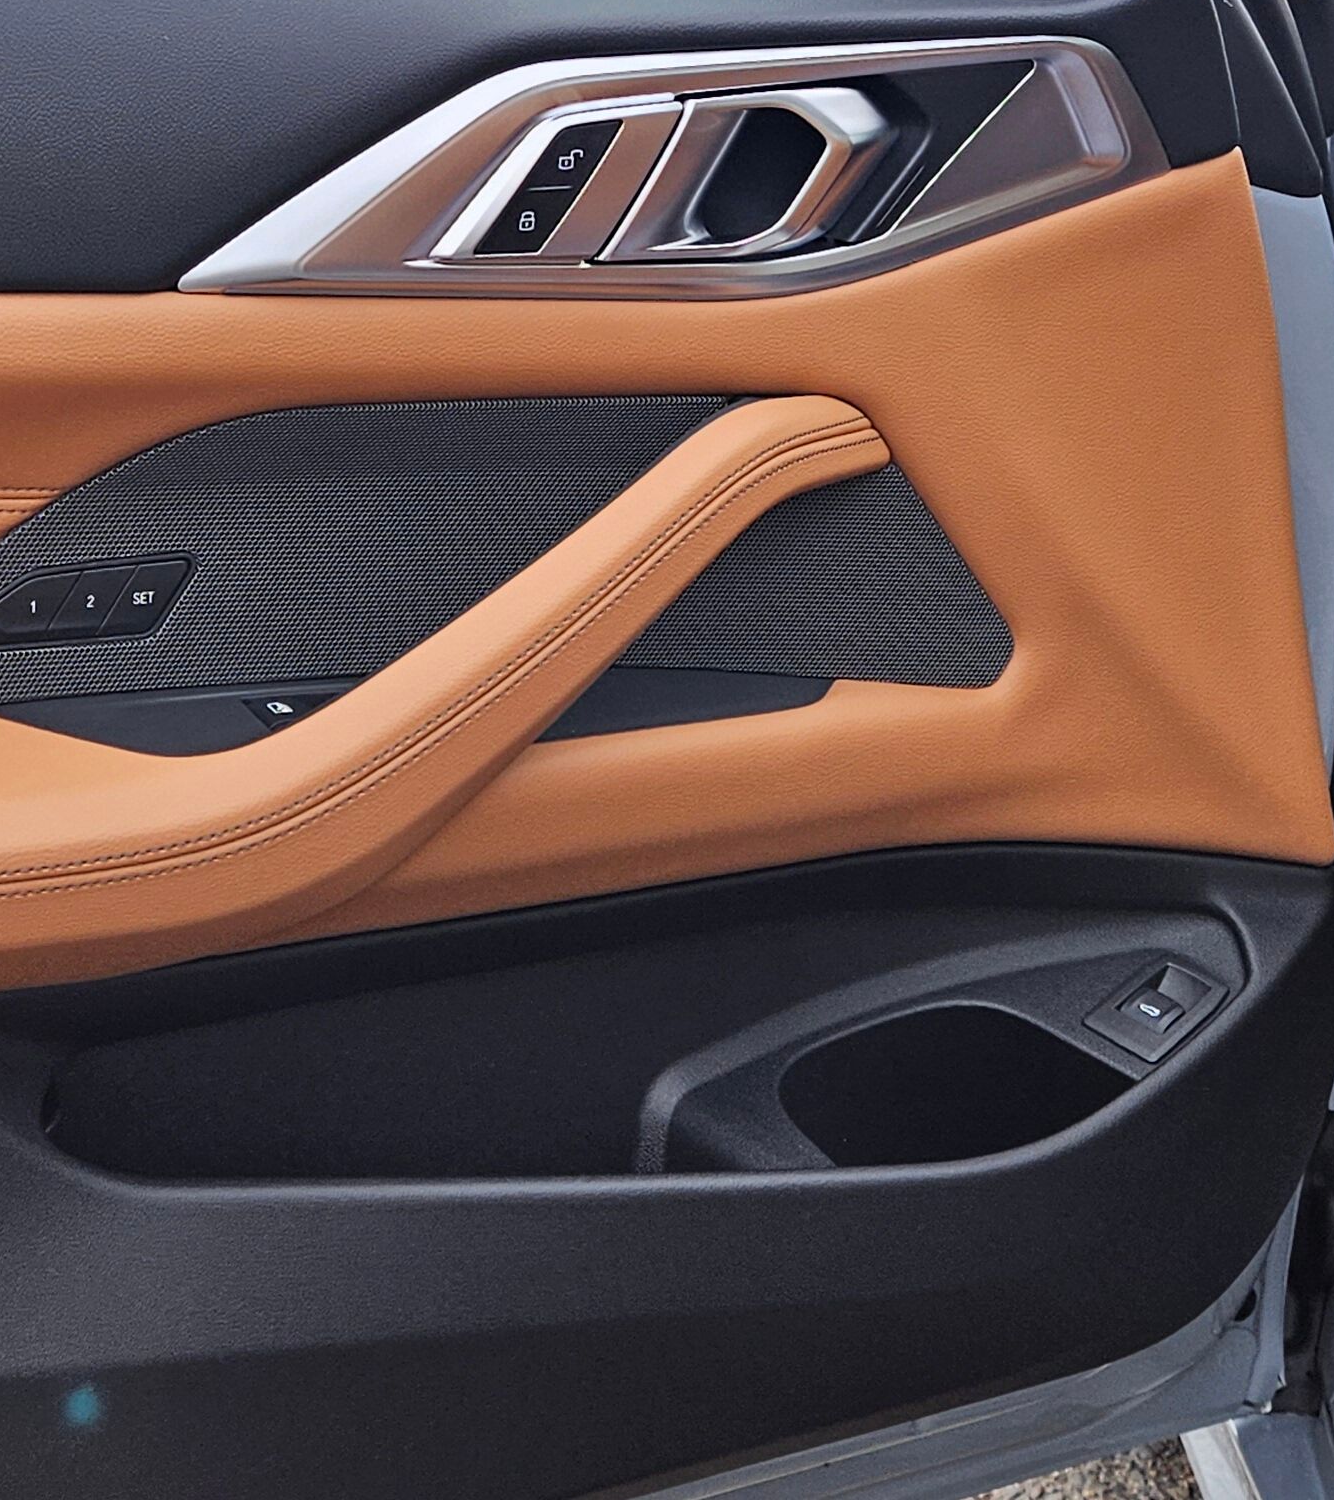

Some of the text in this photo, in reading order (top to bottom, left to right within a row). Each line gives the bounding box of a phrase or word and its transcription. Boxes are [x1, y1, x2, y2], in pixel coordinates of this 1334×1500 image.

[30, 590, 156, 614] 1 2 SET
